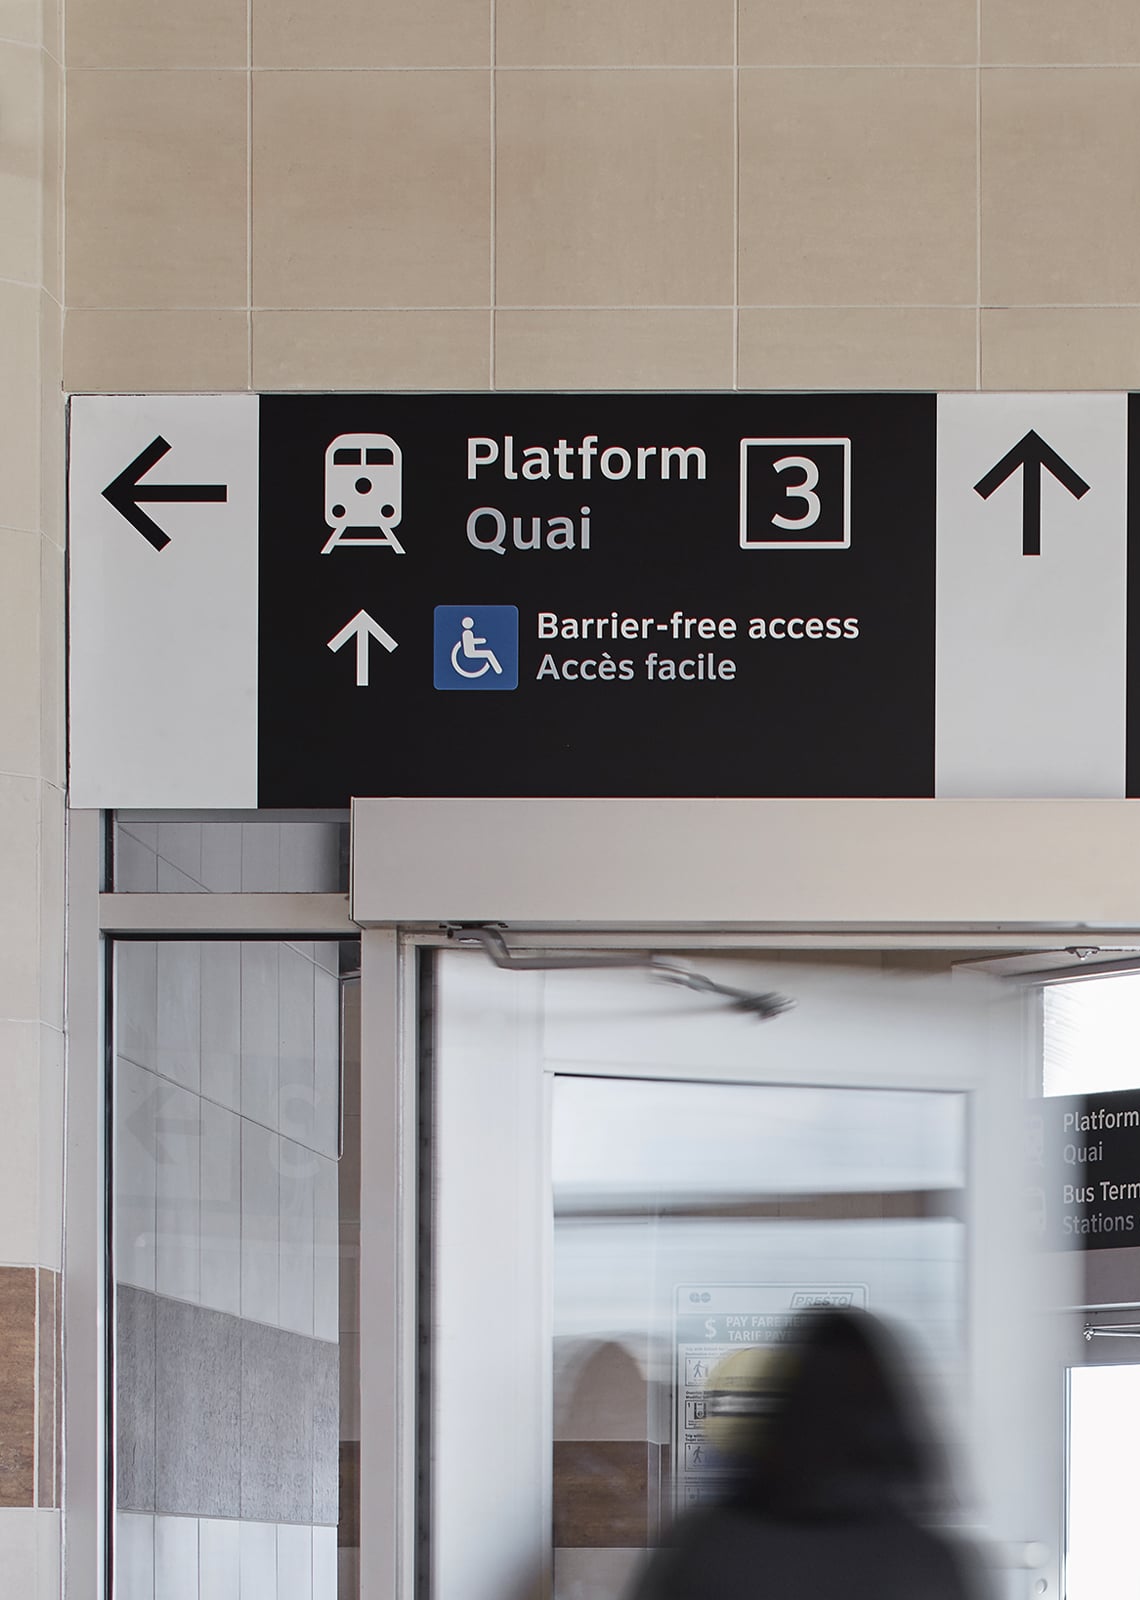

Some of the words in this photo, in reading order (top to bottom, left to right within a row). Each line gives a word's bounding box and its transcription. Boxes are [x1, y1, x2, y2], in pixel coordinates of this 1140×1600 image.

[467, 435, 707, 481] Platform
[770, 456, 821, 530] 3
[466, 505, 591, 555] Quai
[538, 611, 737, 640] Barrier-free
[748, 617, 860, 640] access
[535, 651, 635, 681] Accès
[644, 652, 737, 681] facile
[1063, 1108, 1140, 1133] Platform
[1063, 1141, 1104, 1165] Quai
[1063, 1184, 1095, 1205] Bus
[1063, 1212, 1135, 1235] Stations
[794, 1295, 849, 1307] PRESTO
[726, 1316, 749, 1328] PAY
[751, 1316, 780, 1328] FARE
[728, 1331, 761, 1342] TARIF
